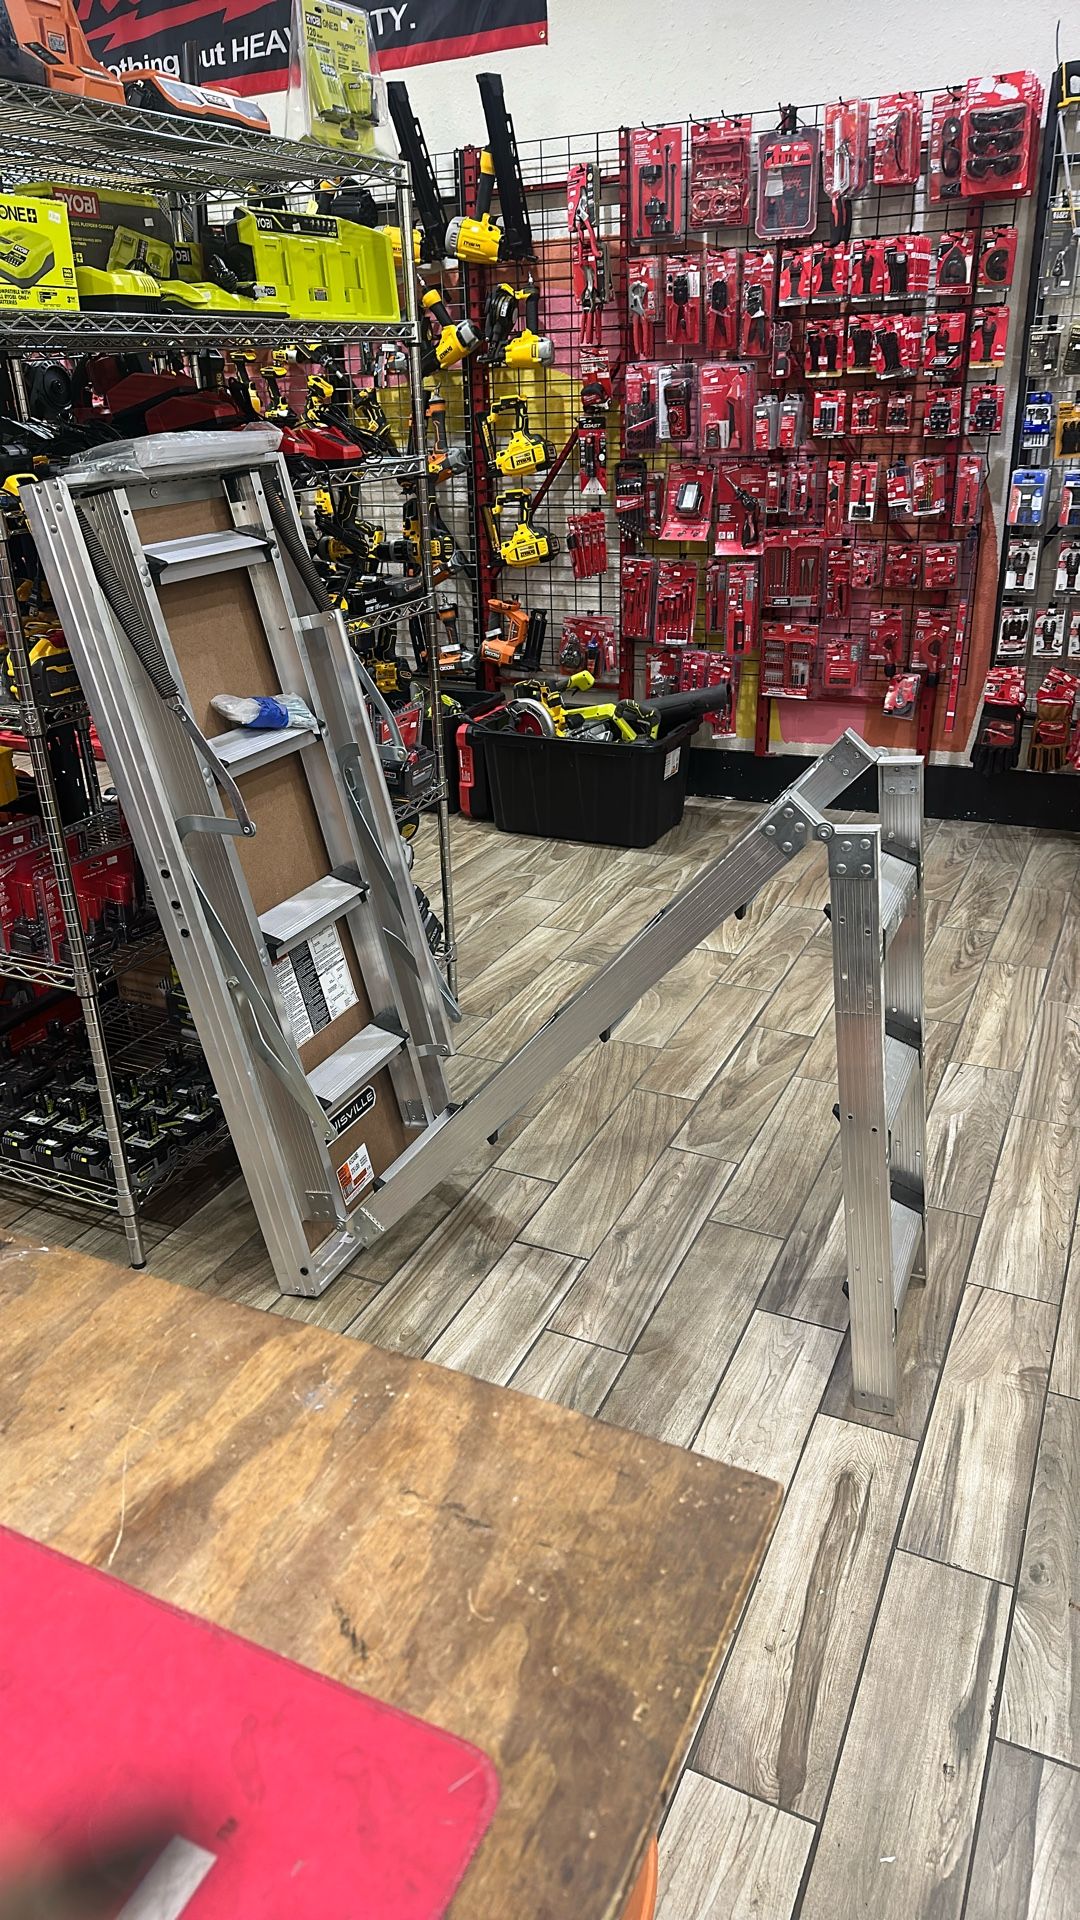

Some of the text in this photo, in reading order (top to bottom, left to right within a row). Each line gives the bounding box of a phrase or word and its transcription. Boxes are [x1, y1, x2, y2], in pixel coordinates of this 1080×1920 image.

[100, 55, 180, 80] othing
[200, 41, 226, 68] ut
[370, 3, 417, 36] TY.
[335, 1092, 373, 1130] UISVILLE
